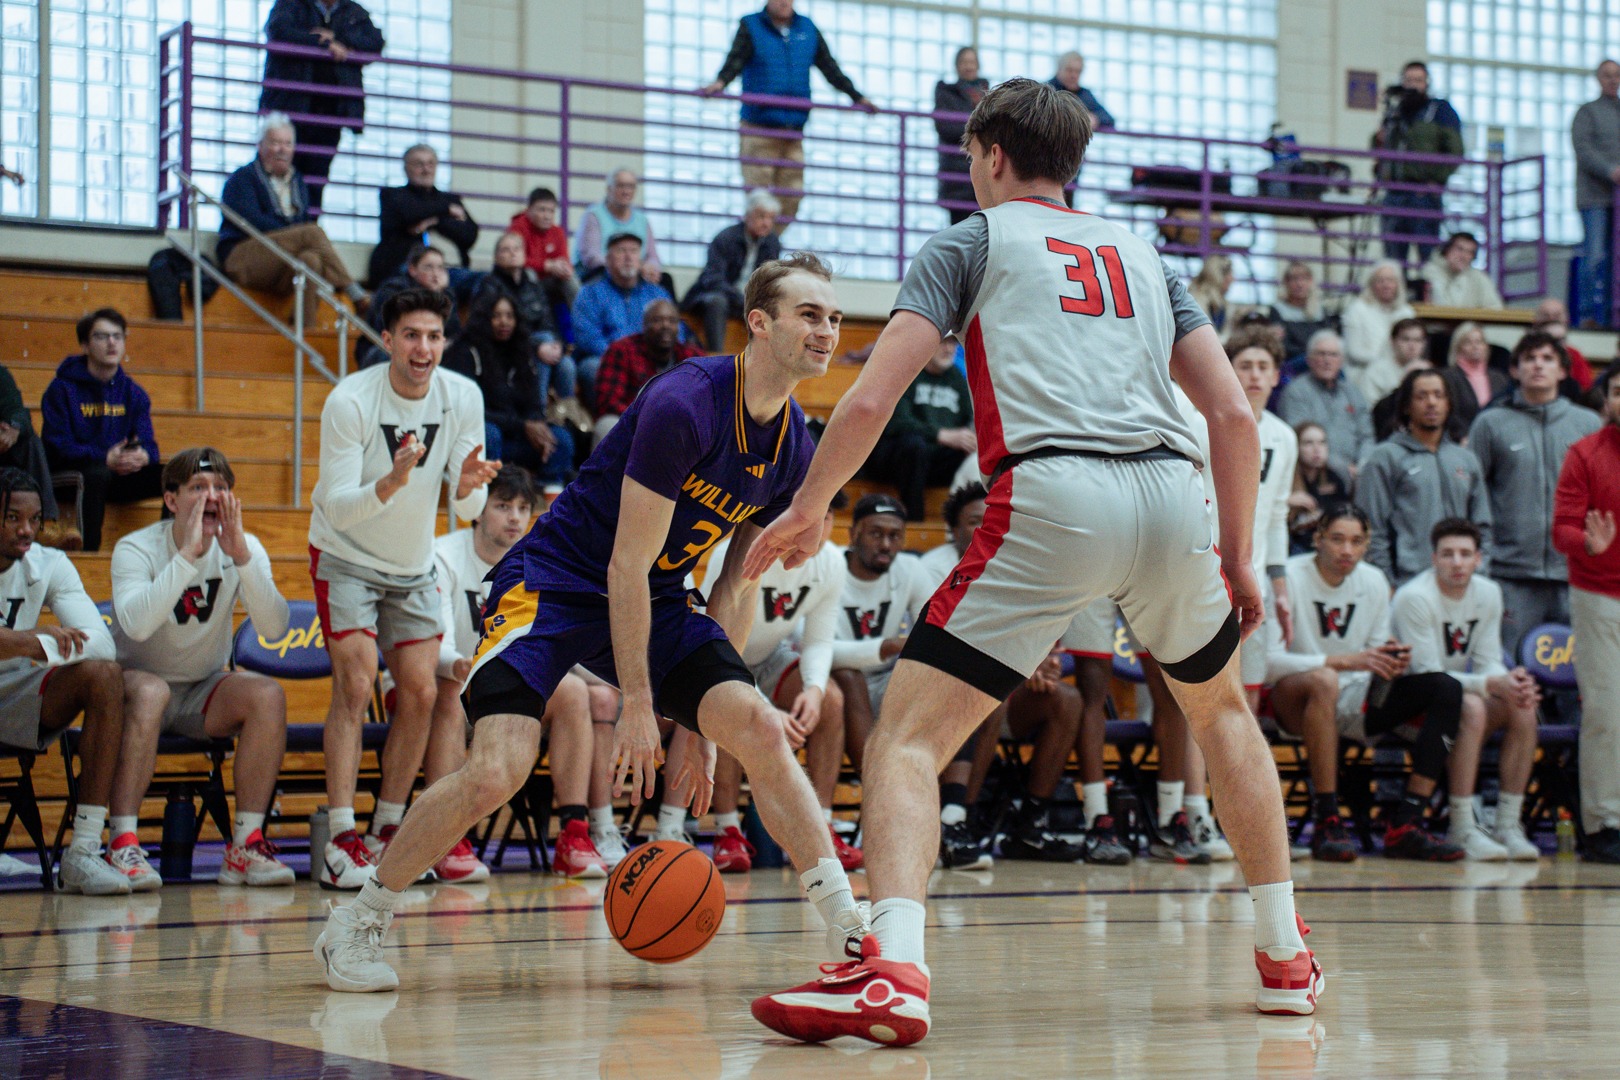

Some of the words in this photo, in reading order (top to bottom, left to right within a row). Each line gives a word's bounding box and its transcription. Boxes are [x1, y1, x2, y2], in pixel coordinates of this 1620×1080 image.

[1045, 236, 1135, 318] 31
[657, 520, 722, 570] 3
[619, 846, 665, 896] NCAA
